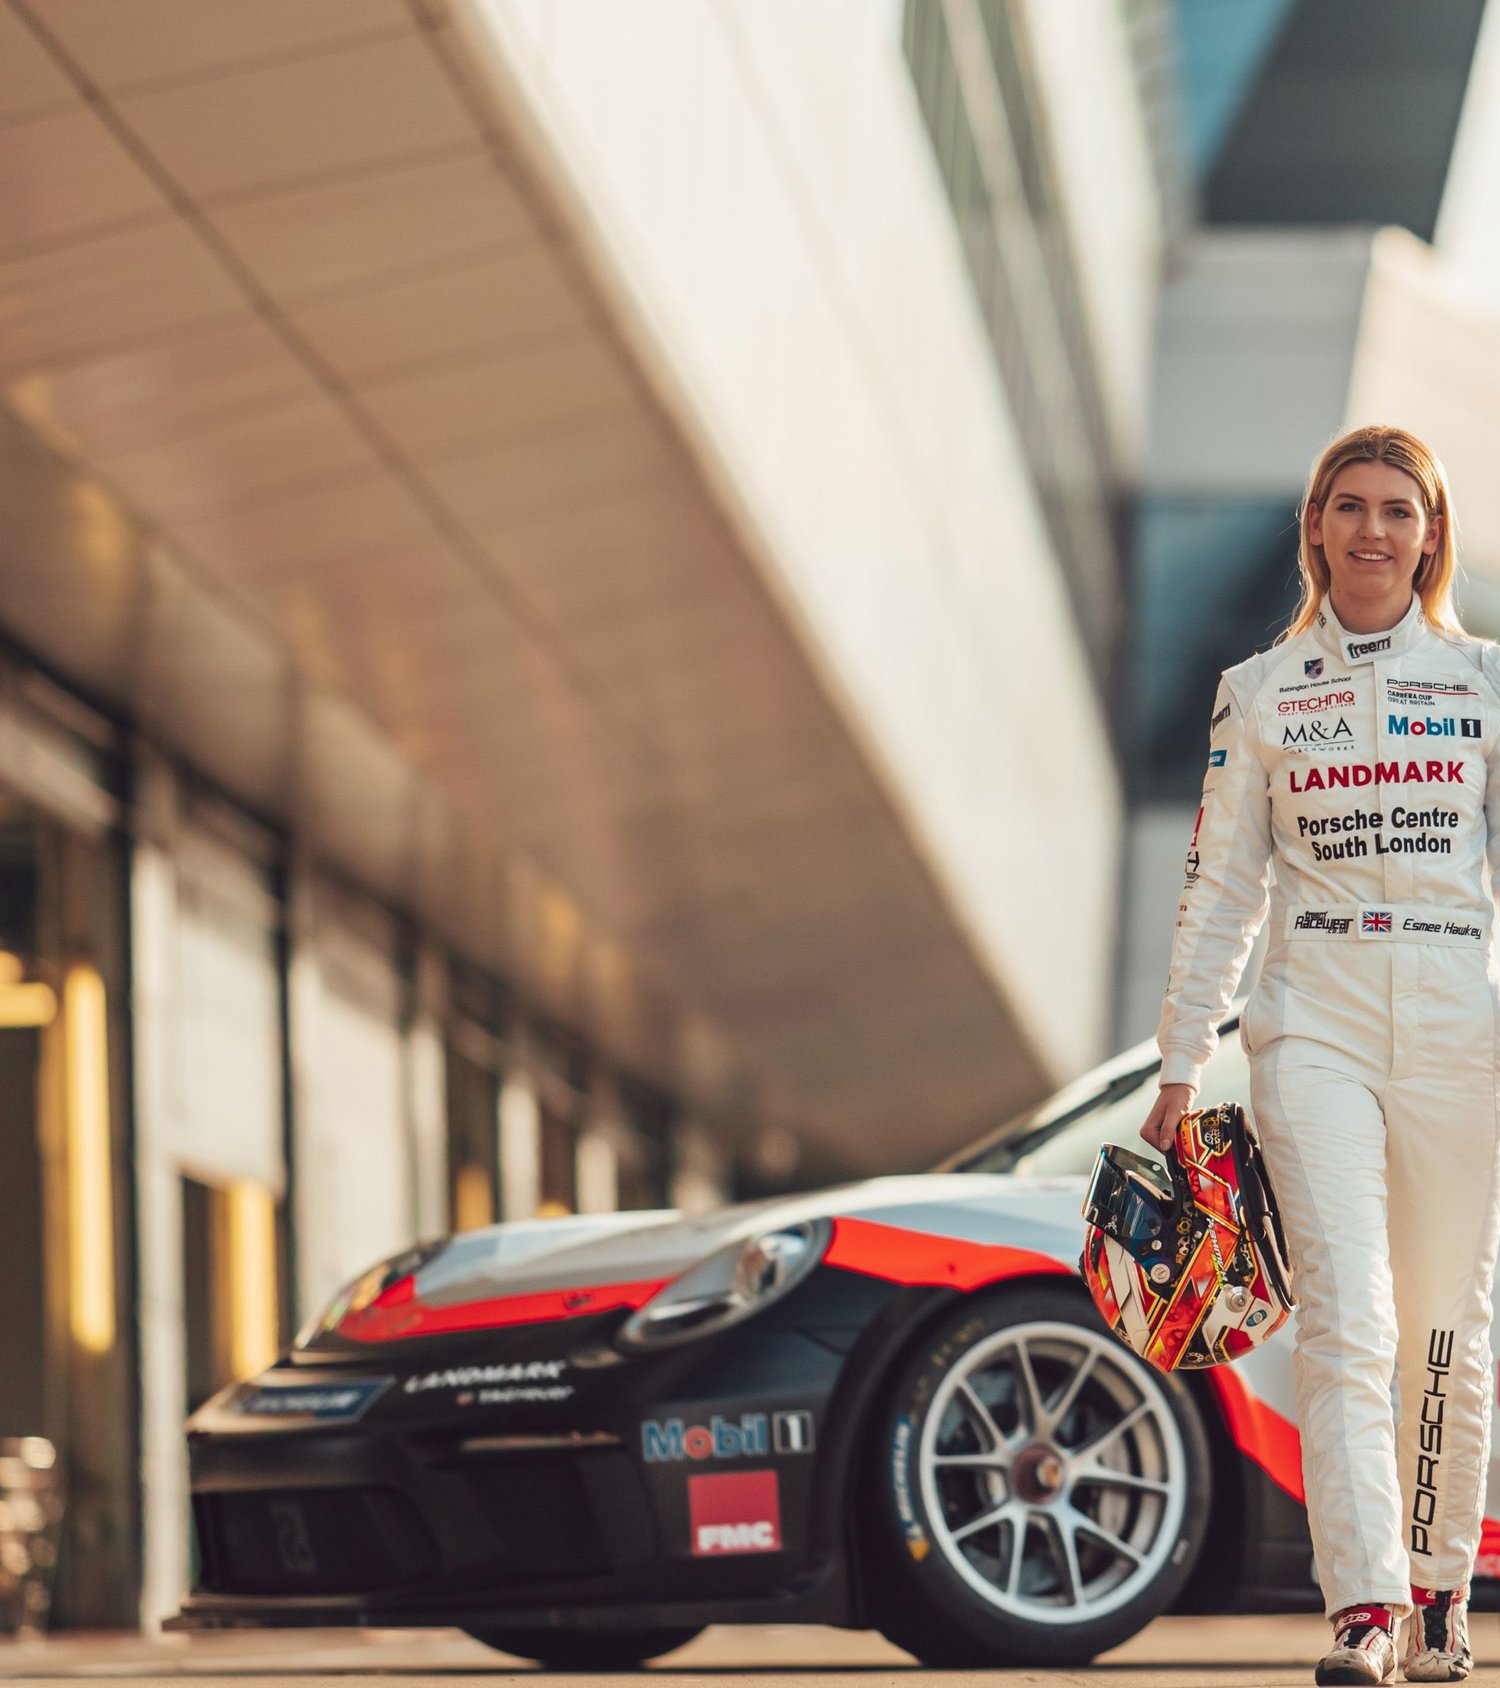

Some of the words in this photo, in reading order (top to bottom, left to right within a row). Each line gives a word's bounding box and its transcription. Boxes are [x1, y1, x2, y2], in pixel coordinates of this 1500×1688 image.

[1347, 636, 1391, 659] freem
[1310, 680, 1329, 688] House
[1331, 676, 1352, 684] School
[1387, 679, 1468, 691] PORSCHE
[1387, 690, 1417, 699] CARRERA
[1282, 716, 1353, 745] M&A
[1388, 715, 1455, 736] Mobil
[1290, 761, 1464, 793] LANDMARK
[1297, 809, 1383, 837] Porsche
[1391, 807, 1458, 828] Centre
[1311, 835, 1367, 861] South
[1375, 832, 1451, 854] London
[1294, 916, 1354, 929] Racewear
[1402, 918, 1441, 933] Esmee
[1444, 921, 1483, 940] Hawkey
[641, 1412, 769, 1463] Mobil
[1411, 1328, 1454, 1557] PORSCHE
[697, 1521, 774, 1551] FMC
